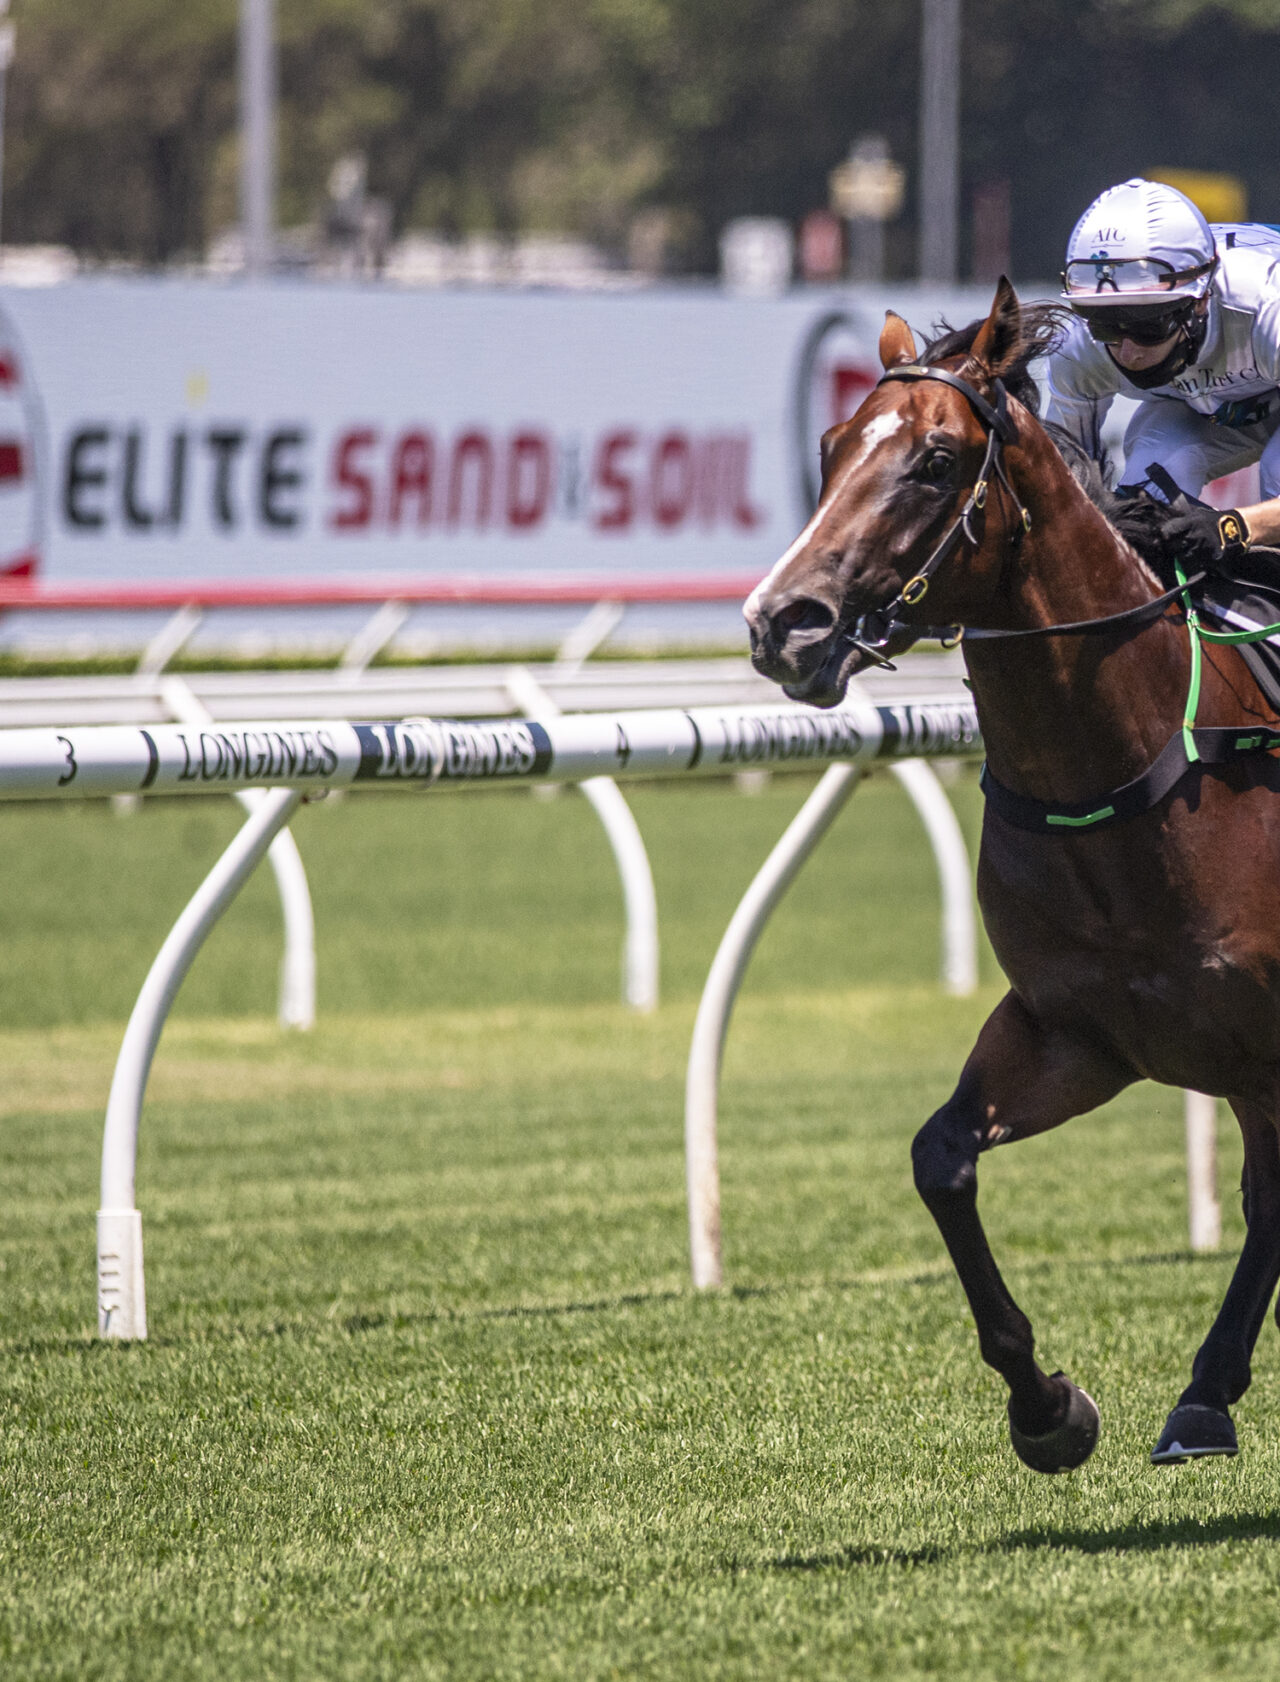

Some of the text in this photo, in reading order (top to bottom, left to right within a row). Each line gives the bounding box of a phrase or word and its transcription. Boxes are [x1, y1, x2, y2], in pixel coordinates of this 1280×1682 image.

[62, 424, 308, 534] ELITE
[328, 424, 552, 534] SAND
[592, 426, 766, 534] SOIL
[56, 735, 78, 787] 3
[177, 729, 339, 783] LONGINES
[615, 720, 632, 770] 4
[719, 711, 863, 763] LONGINES
